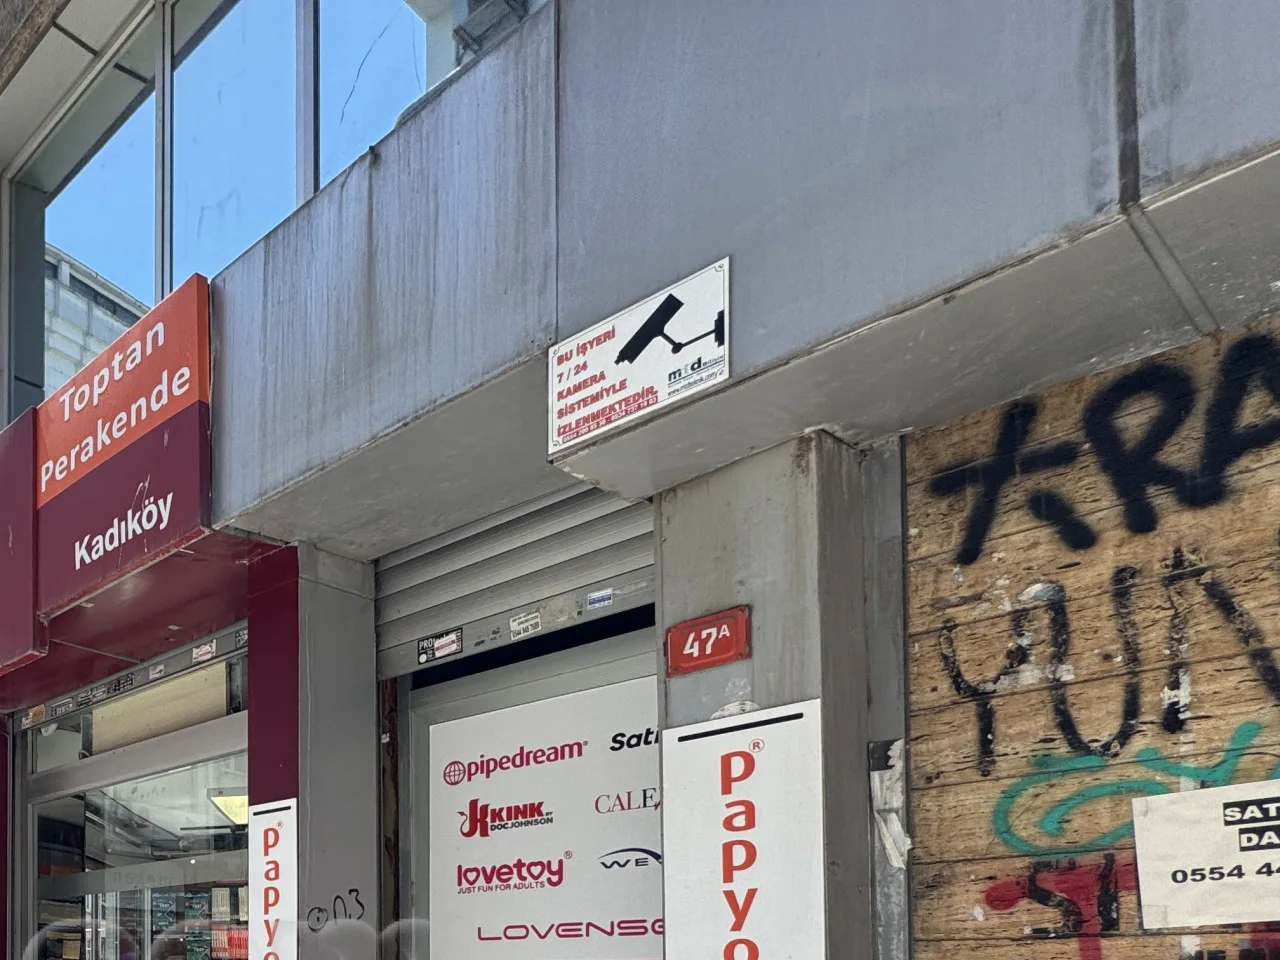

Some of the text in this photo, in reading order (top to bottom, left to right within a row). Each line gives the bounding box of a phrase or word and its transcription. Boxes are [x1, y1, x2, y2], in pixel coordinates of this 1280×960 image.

[557, 325, 616, 366] BU İŞYERİ
[59, 321, 165, 422] Toptan
[573, 361, 587, 377] 24
[557, 371, 606, 402] KAMERA
[557, 378, 627, 420] SİSTEMİYLE
[40, 365, 191, 493] Perakende
[74, 492, 173, 571] Kadıköy
[467, 741, 583, 782] pipedream
[490, 801, 544, 823] KINK
[595, 787, 661, 814] CALE
[457, 858, 564, 888] lovetoy
[457, 881, 545, 895] JUST FUN FOR ADULTS
[1171, 864, 1246, 884] 0554
